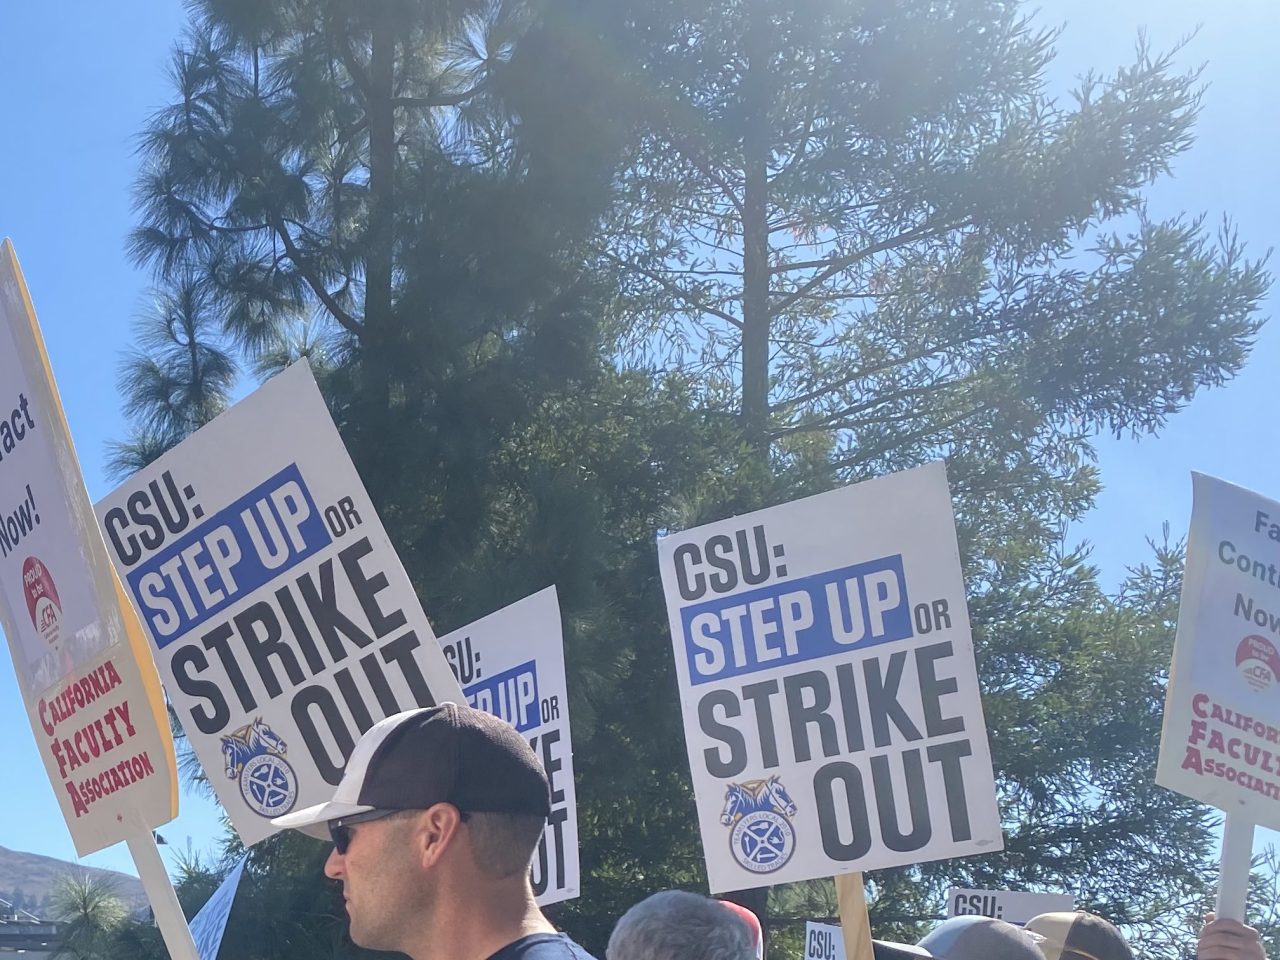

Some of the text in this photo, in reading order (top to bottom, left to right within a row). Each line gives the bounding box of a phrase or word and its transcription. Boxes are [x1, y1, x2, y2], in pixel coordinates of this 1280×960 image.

[103, 470, 205, 567] CSU:
[1255, 510, 1280, 542] Fa
[138, 479, 363, 637] STEP UP OR
[674, 525, 788, 601] CSU:
[1218, 540, 1280, 590] Cont
[170, 536, 407, 735] STRIKE
[690, 568, 952, 676] STEP UP OR
[1233, 593, 1280, 635] Now
[444, 637, 481, 684] SU:
[498, 671, 535, 727] UP
[541, 695, 560, 724] OR
[697, 640, 966, 779] STRIKE
[1192, 693, 1280, 744] CALIFOR
[813, 738, 972, 862] OUT
[1181, 746, 1280, 800] ASSOCIATI
[954, 894, 1002, 920] CSU:
[808, 929, 836, 960] CSU:
